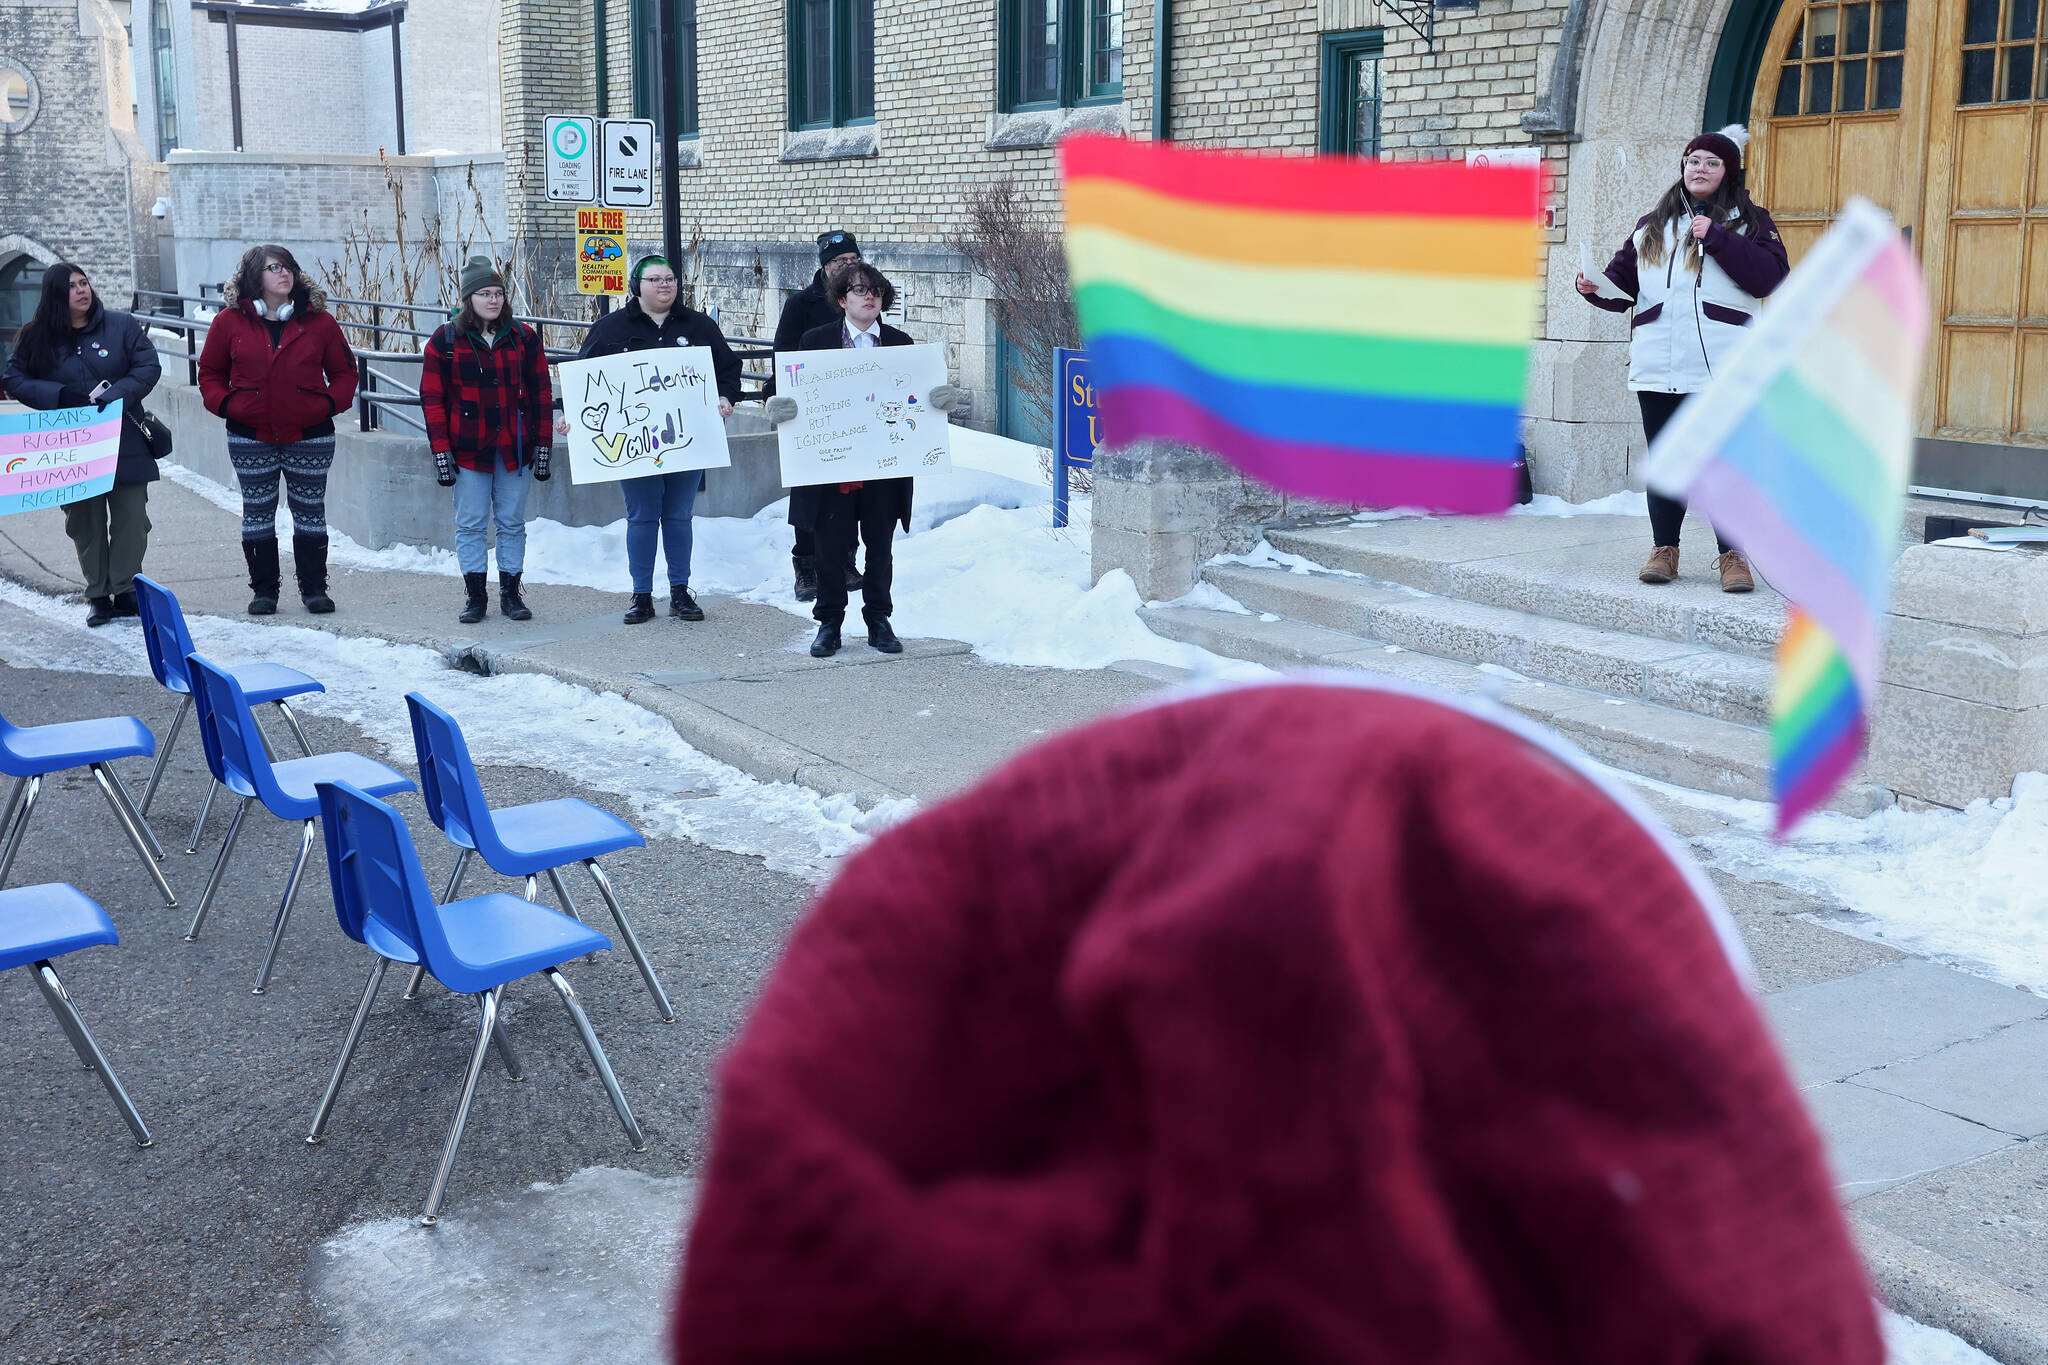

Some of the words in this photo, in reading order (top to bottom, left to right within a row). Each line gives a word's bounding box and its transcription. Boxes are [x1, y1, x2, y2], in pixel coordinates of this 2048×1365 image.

[608, 167, 625, 178] FIRE
[627, 168, 648, 180] LANE
[578, 211, 599, 228] IDLE
[601, 211, 623, 229] FREE
[604, 275, 623, 291] IDLE
[785, 361, 883, 387] TRANSPHOBIA
[584, 369, 626, 415] My
[632, 362, 707, 406] Identity
[805, 388, 820, 402] IS
[805, 398, 852, 416] NOTHING
[23, 408, 92, 430] TRANS
[809, 414, 832, 430] BUT
[23, 427, 92, 449] RIGHTS
[592, 407, 684, 463] Valid!
[794, 424, 868, 449] IGNORANCE
[36, 448, 79, 466] ARE
[20, 464, 88, 488] HUMAN
[22, 481, 88, 508] RIGHTS
